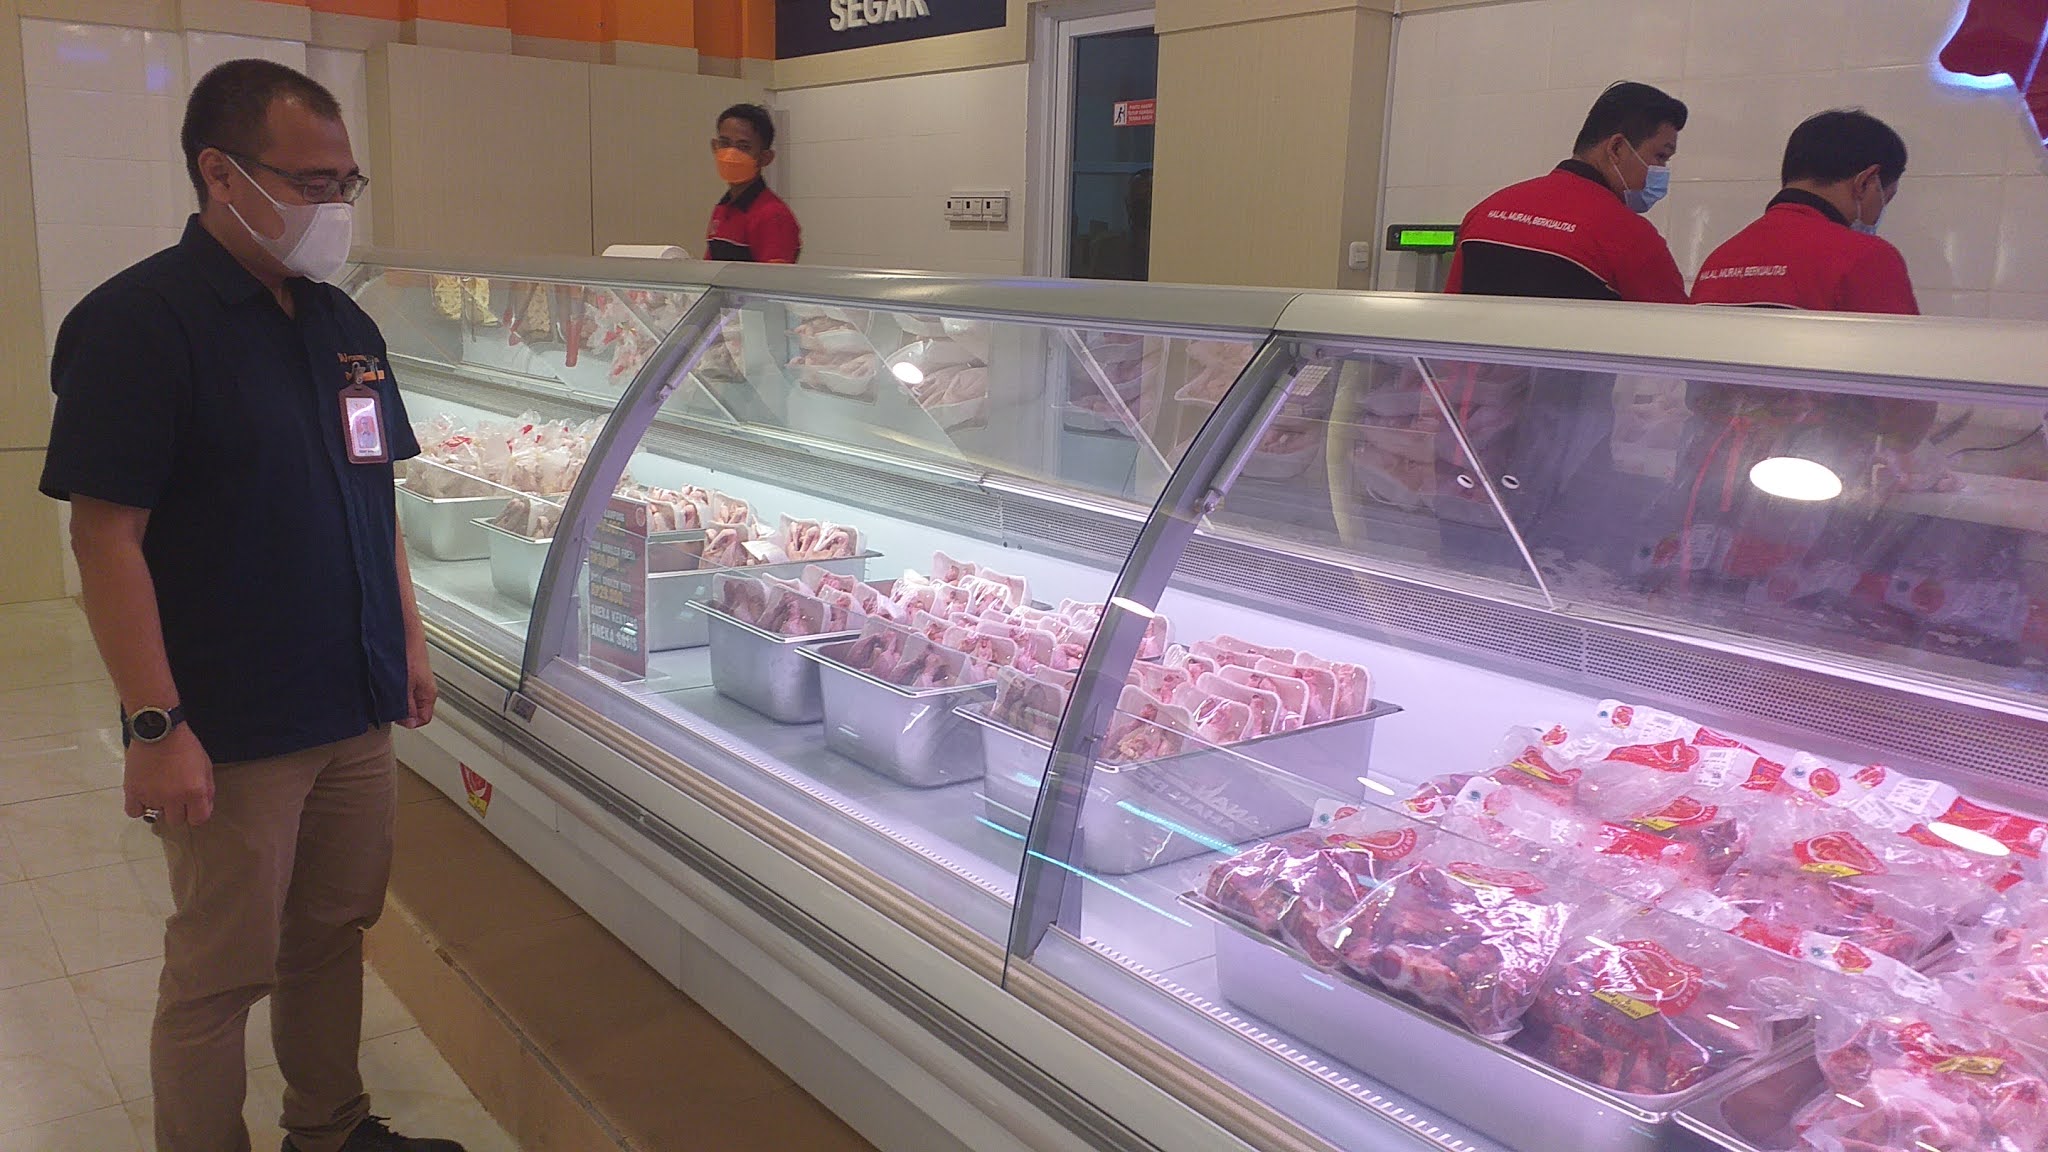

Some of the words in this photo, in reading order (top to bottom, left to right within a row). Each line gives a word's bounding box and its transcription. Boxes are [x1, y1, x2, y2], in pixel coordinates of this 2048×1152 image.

[1488, 210, 1507, 220] HALAL,
[1508, 212, 1532, 225] MURAH,
[1532, 216, 1576, 232] BERKUALITAS
[1744, 265, 1787, 277] BERKUALITAS
[591, 622, 615, 643] ANEKA
